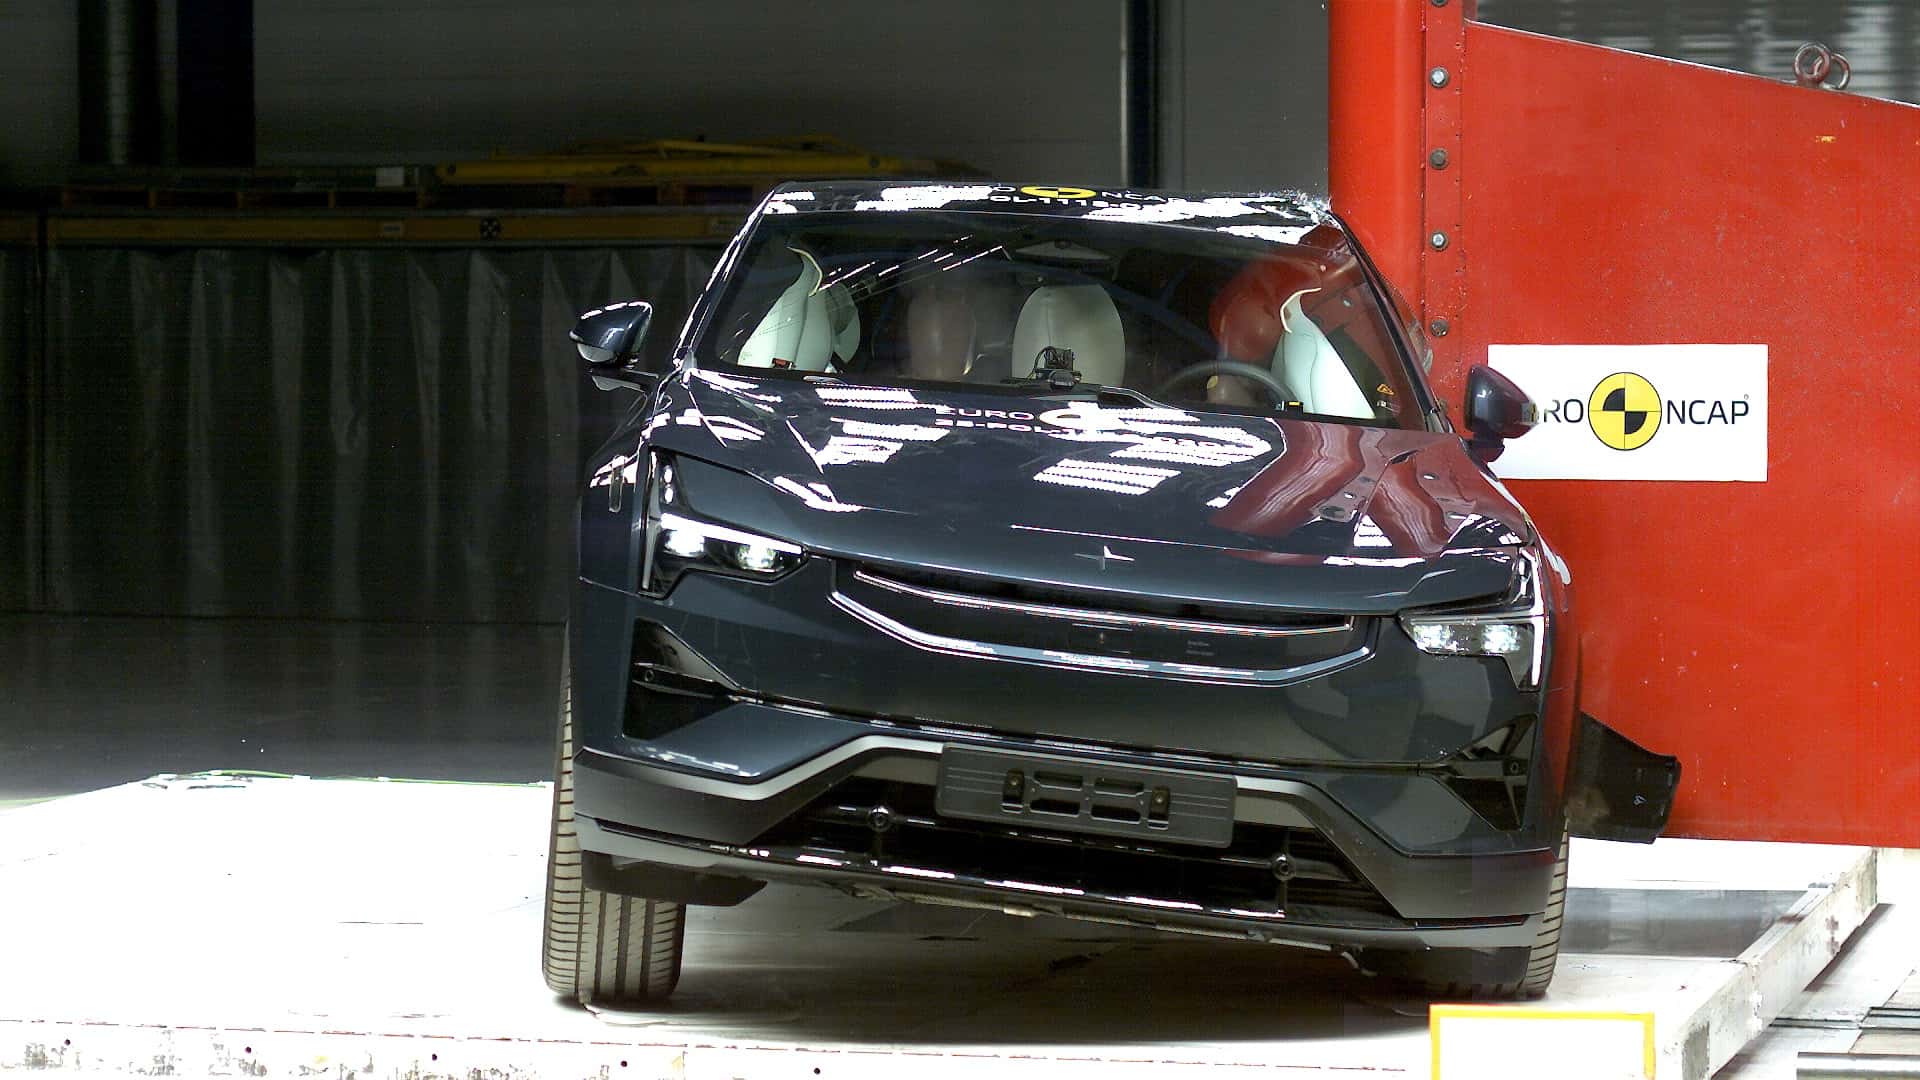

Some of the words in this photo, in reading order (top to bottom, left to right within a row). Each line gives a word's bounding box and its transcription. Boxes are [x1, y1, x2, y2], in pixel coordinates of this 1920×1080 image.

[935, 407, 1035, 421] EURO
[1543, 398, 1585, 423] RO
[1666, 400, 1749, 424] NCAP
